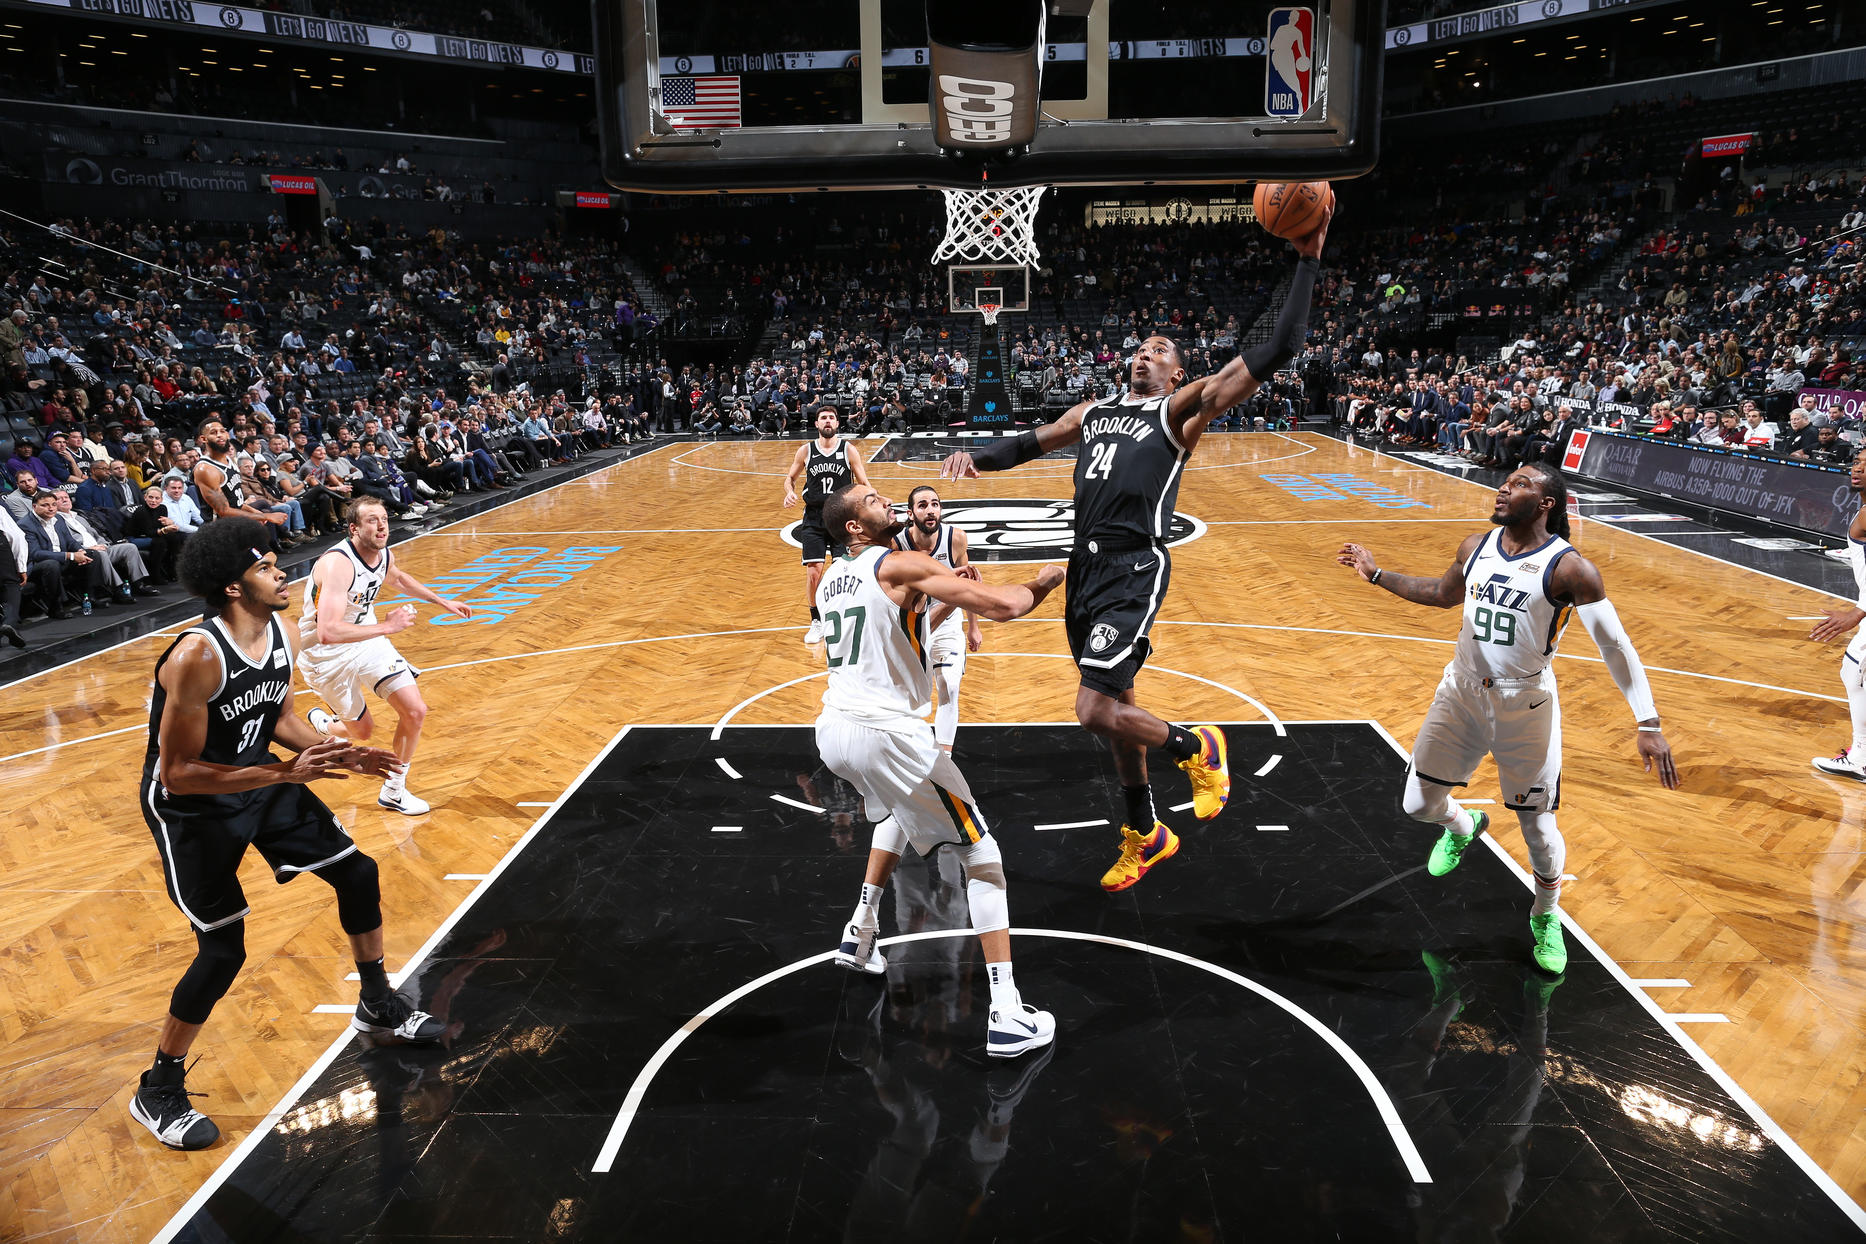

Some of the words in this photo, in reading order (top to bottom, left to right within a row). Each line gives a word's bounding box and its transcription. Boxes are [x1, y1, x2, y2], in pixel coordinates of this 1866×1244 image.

[145, 0, 192, 22] NETS
[273, 15, 301, 36] LET'S
[307, 22, 325, 40] GO
[328, 22, 367, 45] NETS
[1435, 20, 1457, 40] LET'S
[1463, 16, 1477, 33] GO
[1482, 8, 1518, 30] NETS
[443, 38, 466, 57] LET'S
[471, 43, 486, 60] GO
[488, 43, 523, 64] NETS
[914, 49, 924, 64] 6
[1047, 44, 1057, 59] 5
[1191, 38, 1225, 57] NETS
[721, 55, 743, 72] LET'S
[748, 56, 762, 71] GO
[791, 60, 797, 69] 2
[808, 59, 813, 68] 7
[939, 75, 1015, 143] GEICO
[1272, 93, 1294, 110] NBA
[1713, 142, 1737, 152] LUCAS
[111, 168, 167, 188] Grant
[165, 170, 248, 192] Thornton
[282, 180, 304, 190] LUCAS
[304, 181, 315, 190] OIL
[584, 196, 601, 204] LUCAS
[601, 197, 609, 205] OIL
[1105, 209, 1120, 218] WE
[1123, 209, 1136, 218] GO
[1221, 207, 1236, 216] WE
[1239, 207, 1252, 217] GO
[1561, 397, 1592, 410] HONDA
[1604, 405, 1640, 417] HONDA
[973, 414, 1009, 423] BARCLAYS
[1083, 415, 1155, 445] BROOKLYN
[1569, 443, 1584, 456] infor
[1603, 442, 1642, 465] QATAR
[809, 462, 846, 477] BROOKLYN
[1085, 442, 1118, 480] 24
[1688, 457, 1712, 475] NOW
[1710, 460, 1745, 482] FLYING
[1744, 466, 1768, 486] THE
[821, 477, 834, 495] 12
[1258, 473, 1349, 502] CENTER
[1307, 473, 1435, 509] BARCLAYS
[1654, 469, 1687, 490] AIRBUS
[1684, 477, 1735, 502] A350-1000
[1734, 487, 1759, 506] OUT
[1758, 491, 1774, 510] OF
[1774, 495, 1796, 516] JFK
[428, 546, 624, 626] BARCLAYS
[823, 575, 863, 603] GOBERT
[1470, 573, 1532, 613] JAZZ
[825, 606, 867, 668] 27
[1093, 624, 1117, 641] NETS
[1472, 606, 1517, 646] 99
[219, 680, 290, 722] BROOKLYN
[237, 713, 266, 754] 31
